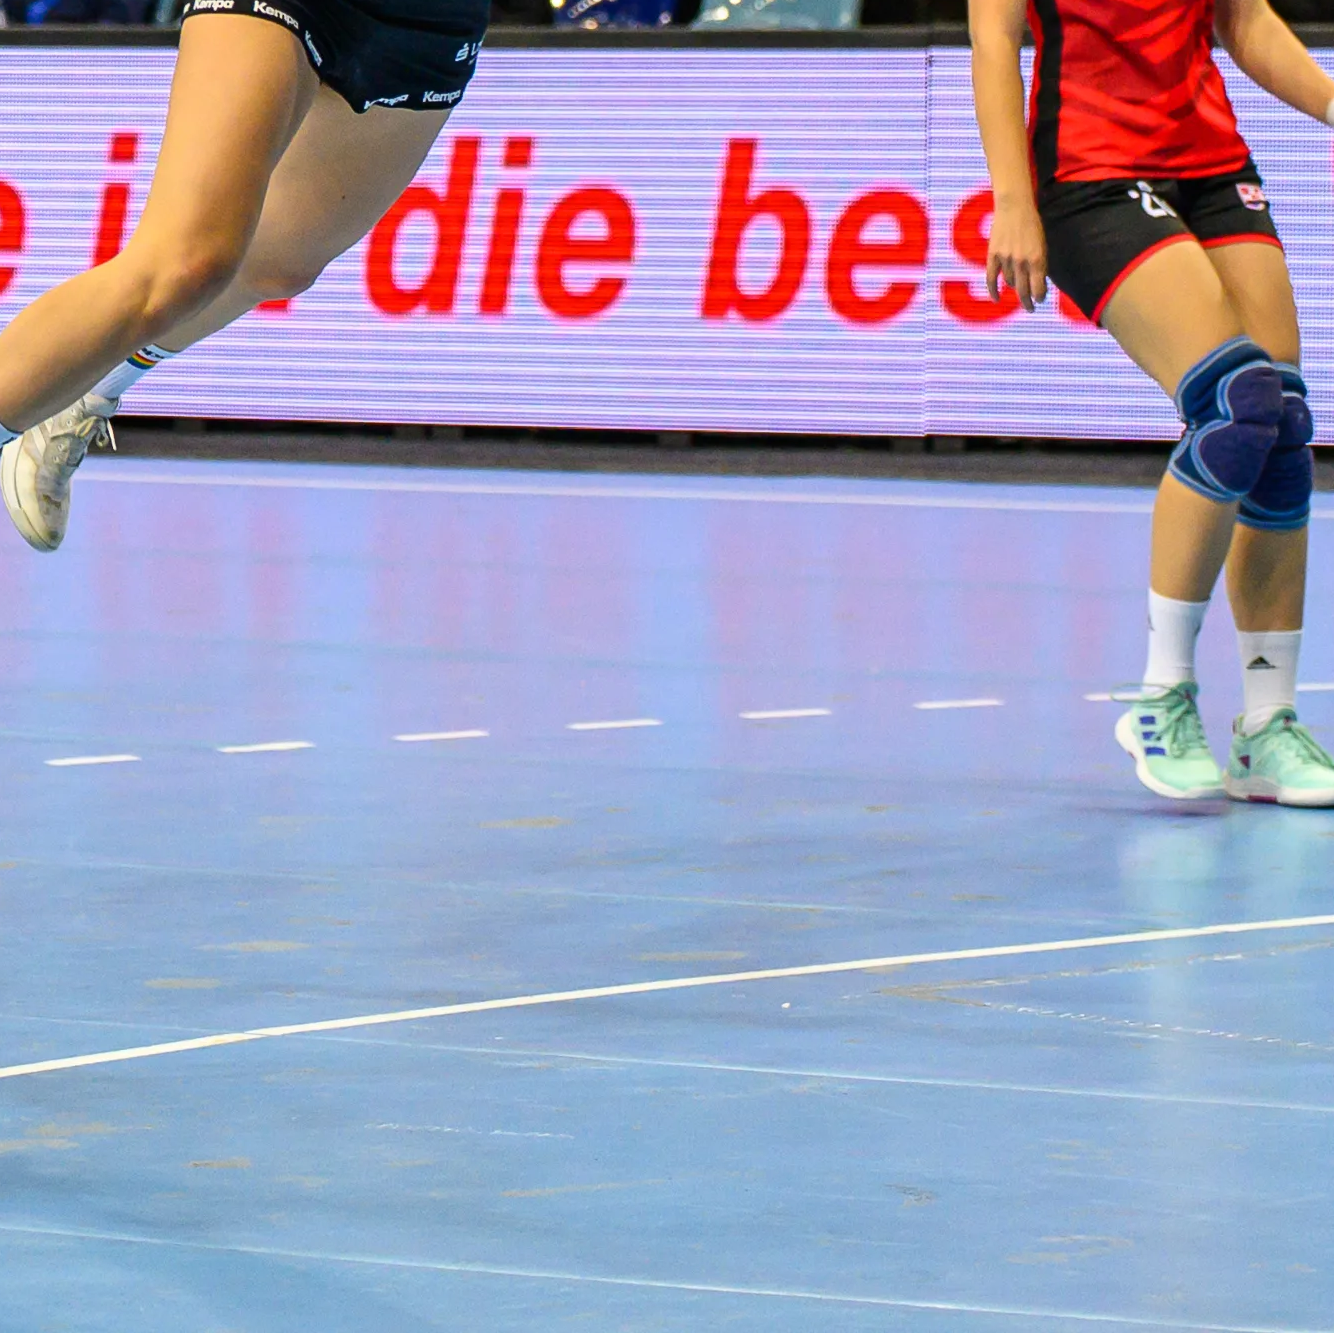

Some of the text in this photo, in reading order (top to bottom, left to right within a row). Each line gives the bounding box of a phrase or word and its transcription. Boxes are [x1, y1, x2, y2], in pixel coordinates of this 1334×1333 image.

[253, 0, 299, 29] Kempa
[422, 90, 462, 104] Kempa
[367, 138, 635, 318] die
